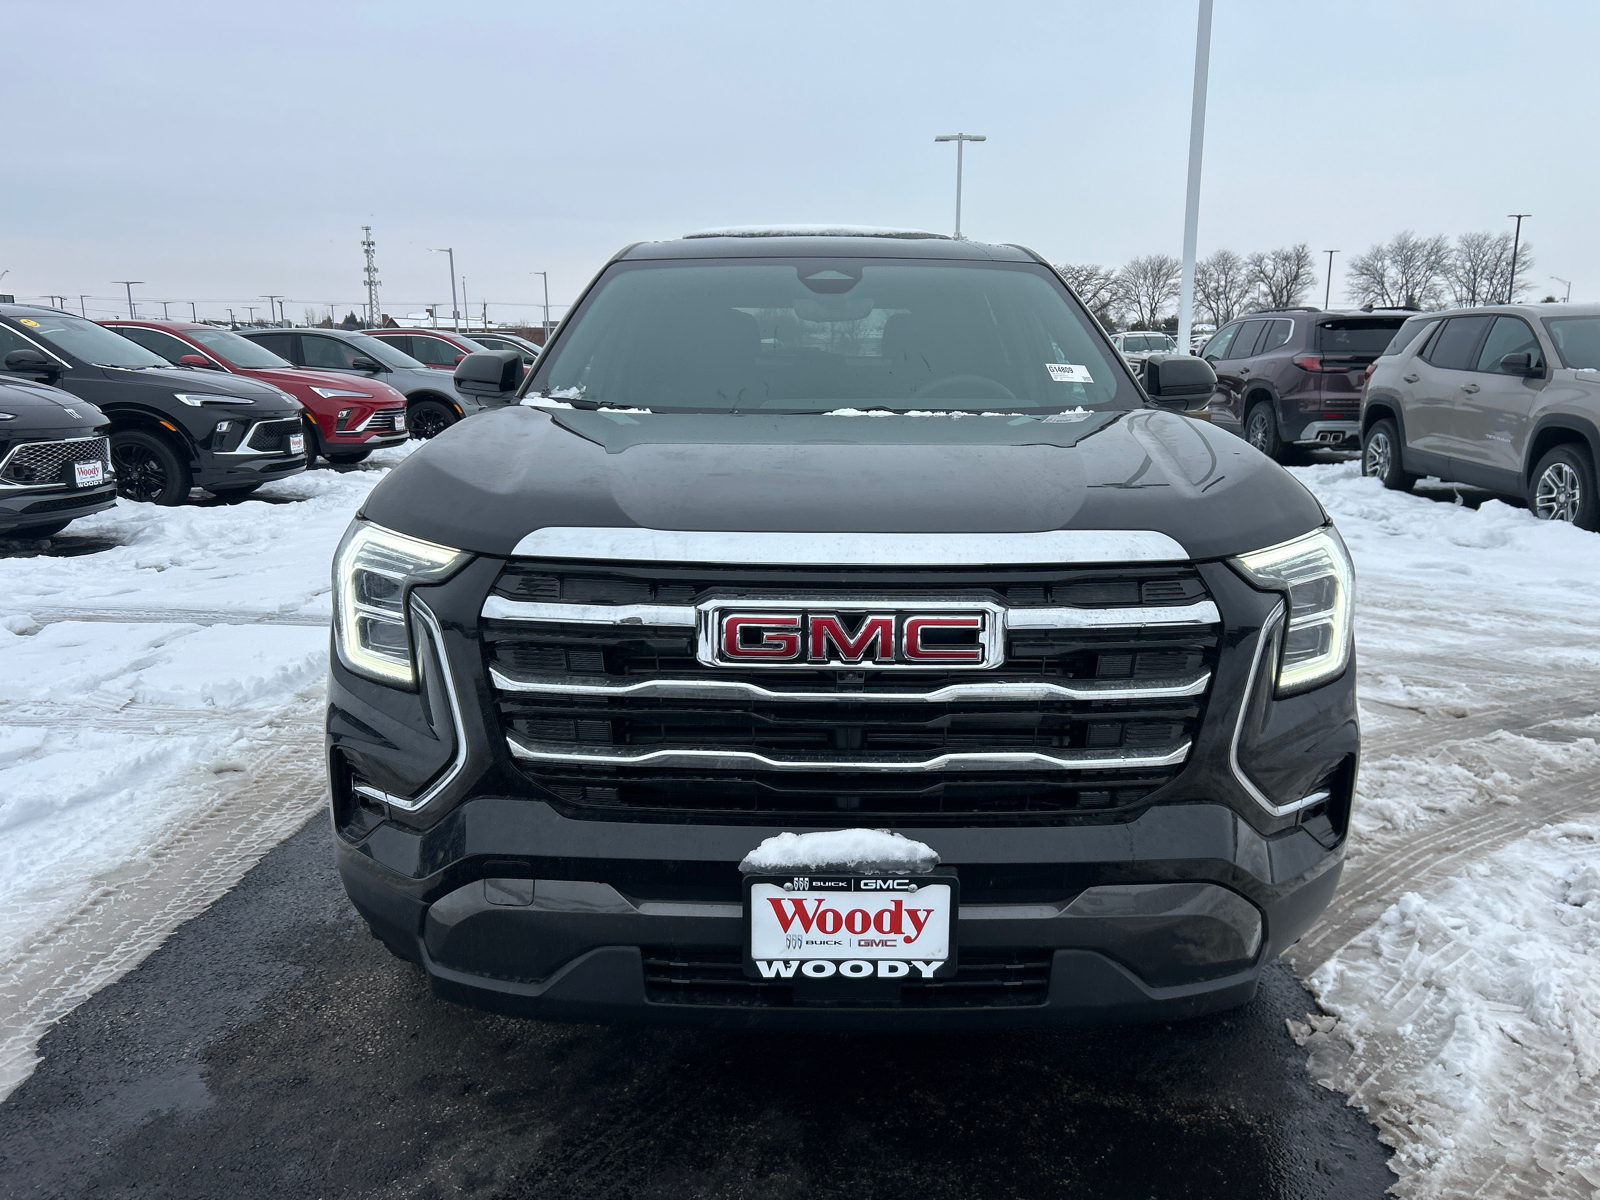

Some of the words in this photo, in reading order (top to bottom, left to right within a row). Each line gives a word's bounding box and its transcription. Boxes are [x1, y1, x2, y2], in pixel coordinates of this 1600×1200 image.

[76, 465, 100, 477] Woody
[721, 614, 983, 662] GMC
[860, 879, 910, 890] GMC
[766, 897, 935, 944] Woody
[857, 938, 897, 948] GMC
[755, 960, 945, 978] WOODY
